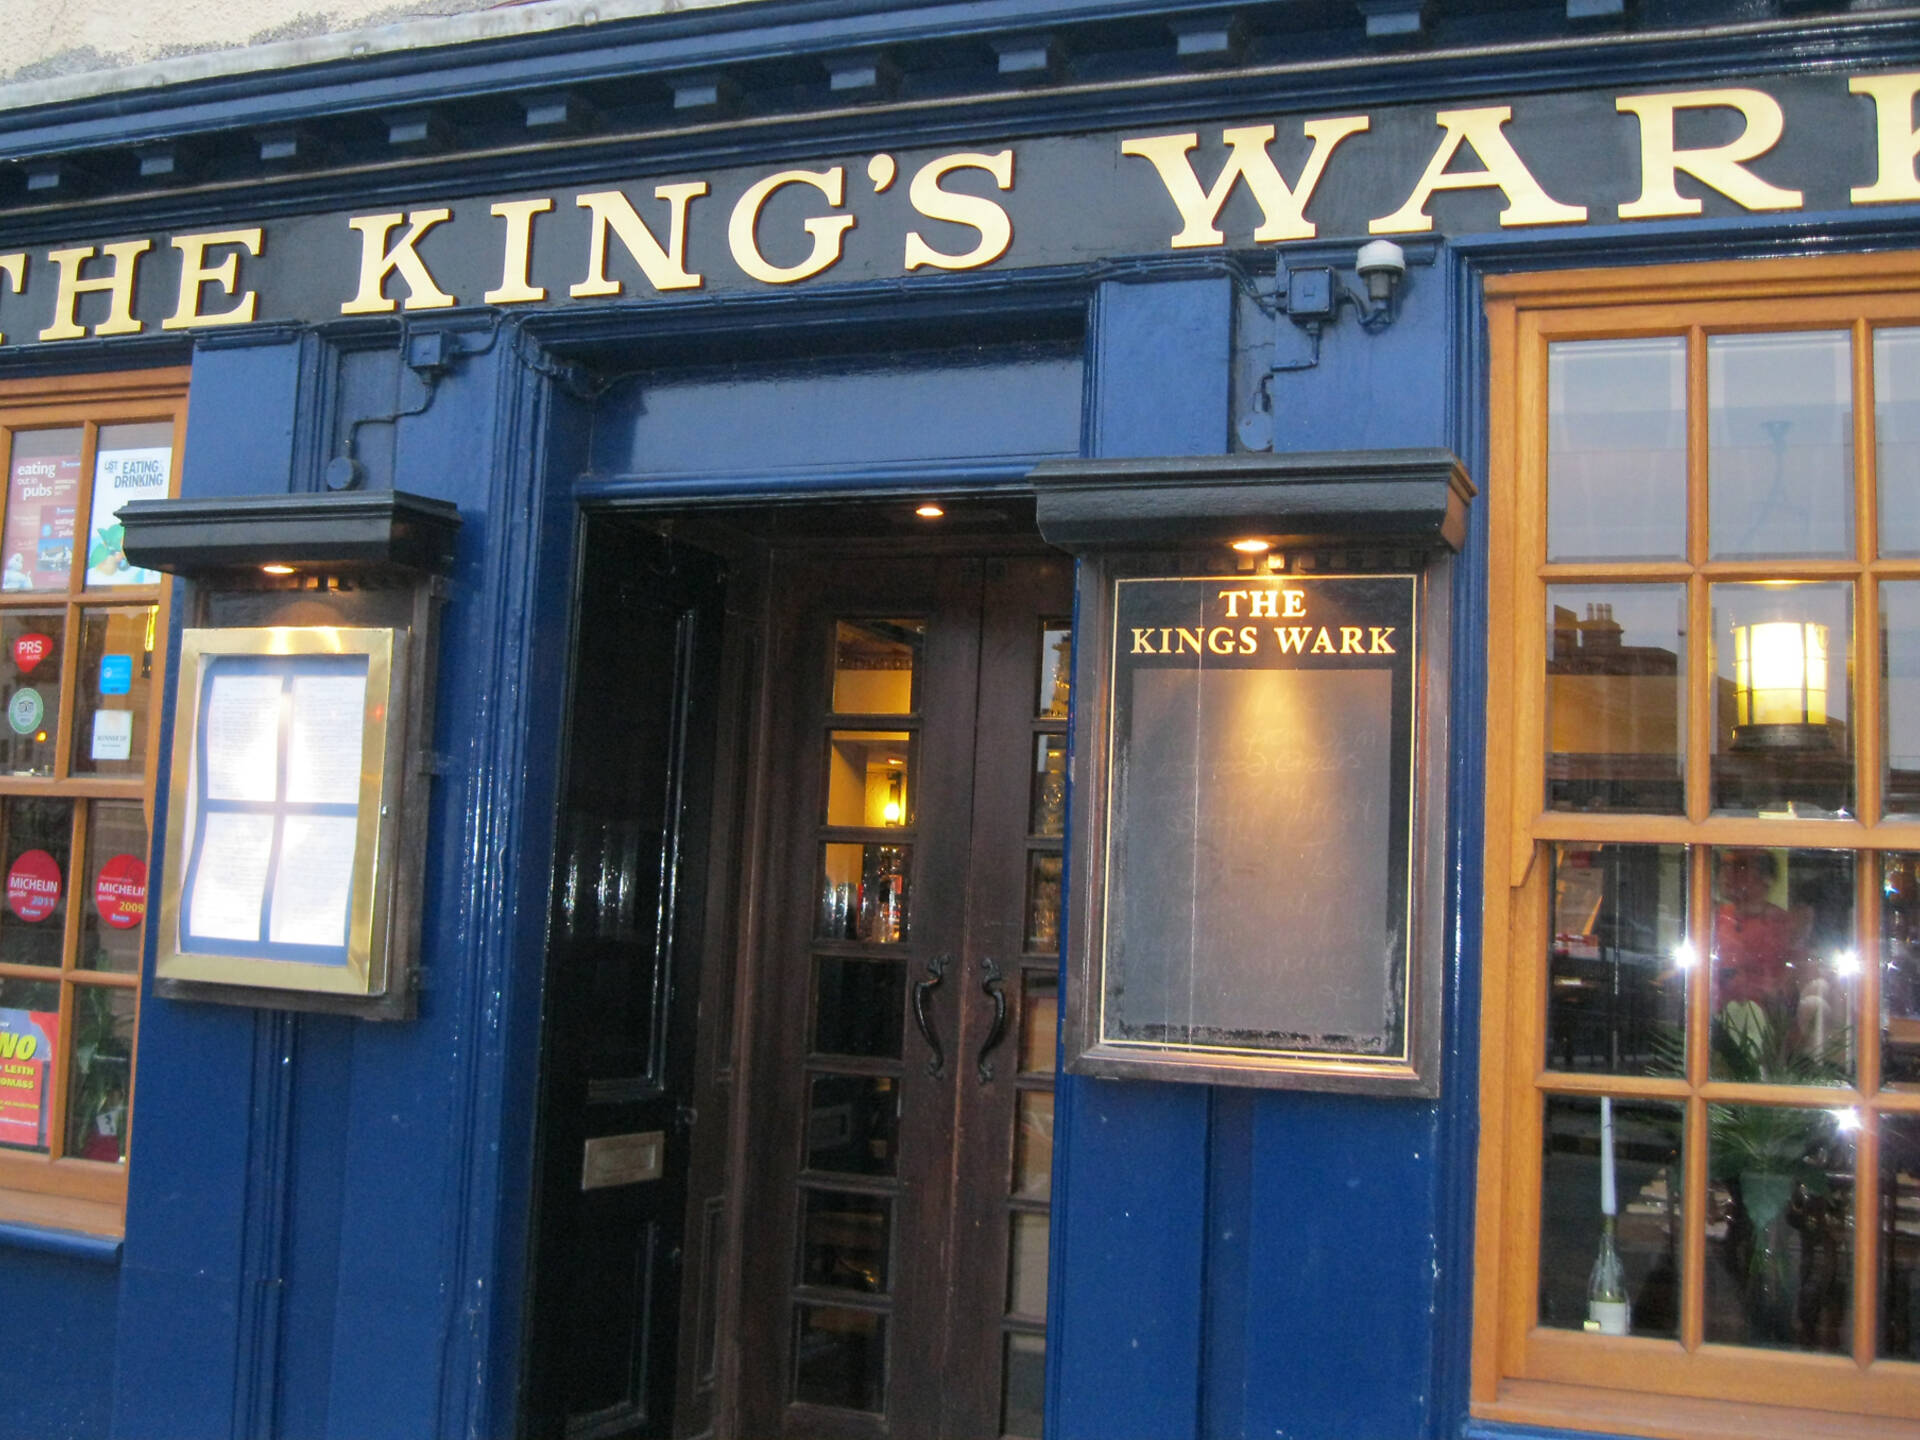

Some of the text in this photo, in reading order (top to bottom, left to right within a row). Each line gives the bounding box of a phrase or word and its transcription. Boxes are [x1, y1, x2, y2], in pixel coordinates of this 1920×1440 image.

[341, 150, 1013, 314] KING'S
[17, 461, 56, 478] eating
[122, 460, 160, 474] EATING
[114, 473, 163, 488] DRINKING
[24, 483, 53, 500] pubs
[1218, 590, 1306, 618] THE
[18, 640, 43, 654] PRS
[1130, 626, 1396, 654] KINGS WARK
[10, 876, 58, 893] MICHELIN
[119, 901, 144, 913] 2009
[4, 1064, 35, 1076] LEITH
